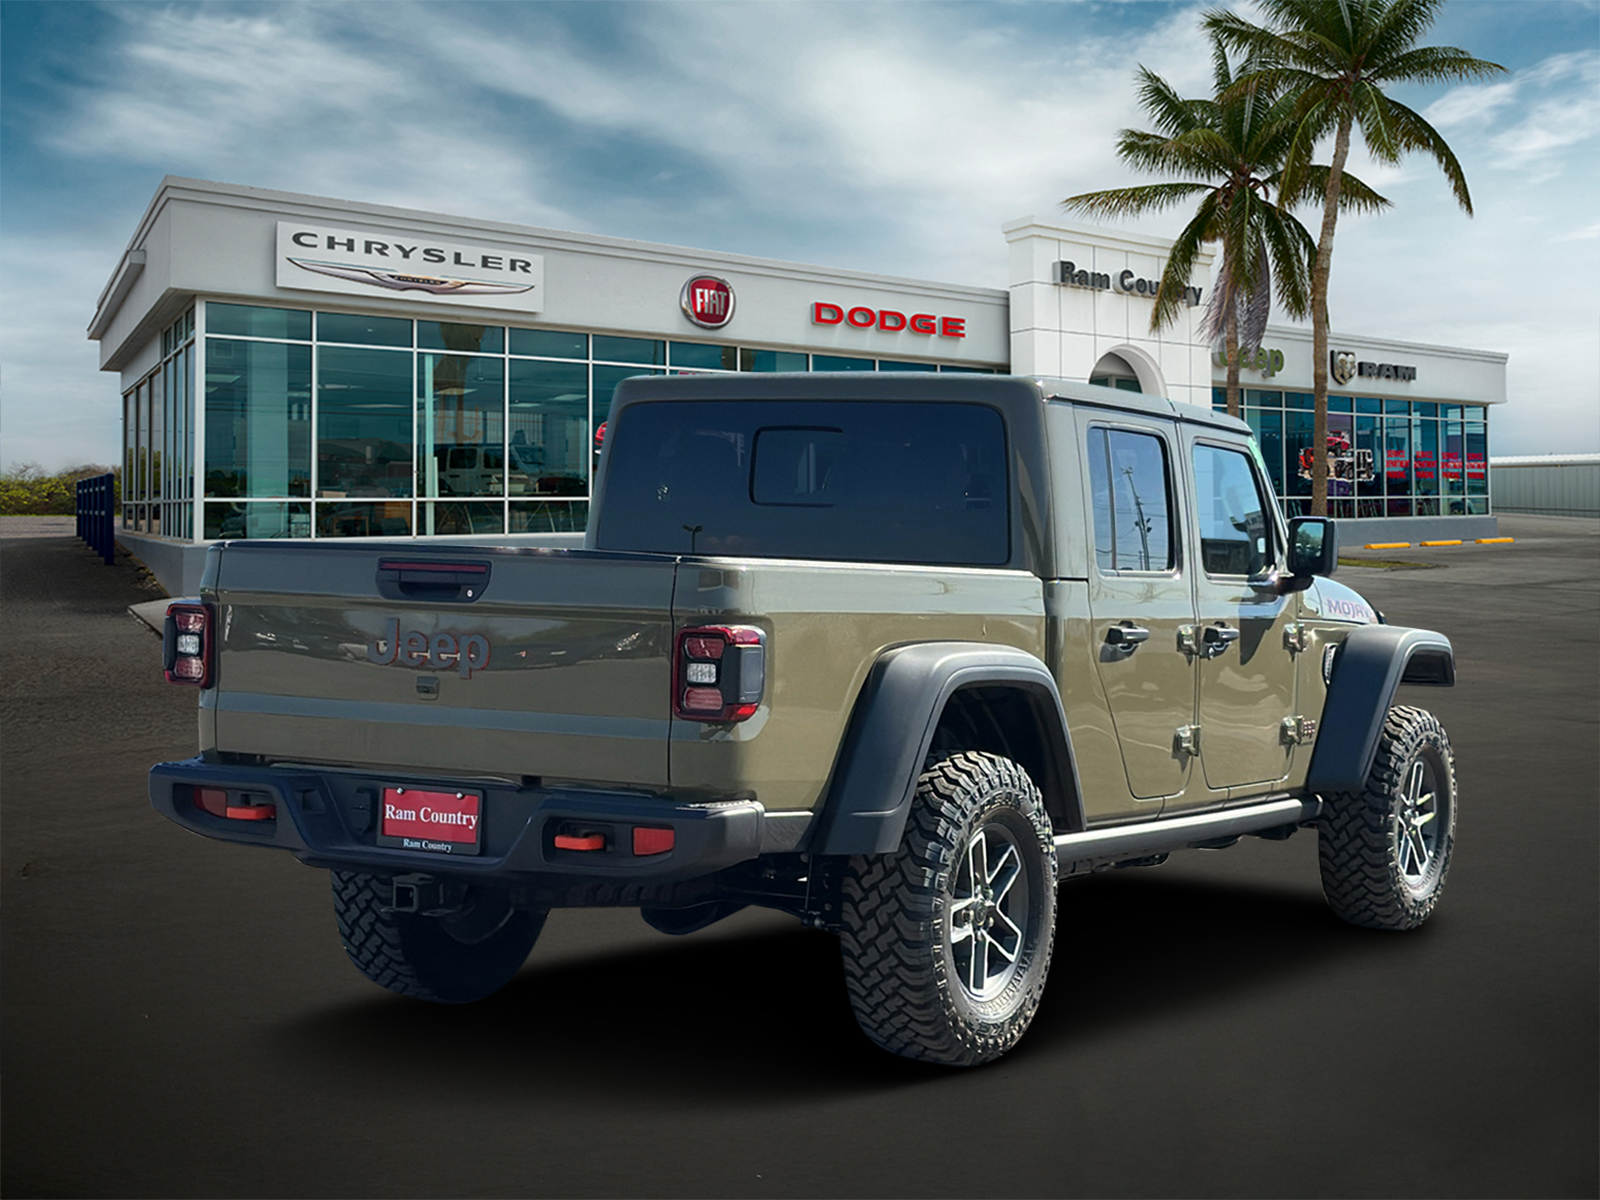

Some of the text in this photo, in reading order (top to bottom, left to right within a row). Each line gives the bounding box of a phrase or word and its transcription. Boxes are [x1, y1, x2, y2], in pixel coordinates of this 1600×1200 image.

[291, 231, 533, 274] CHRYSLER
[1052, 260, 1203, 307] Ram Coury
[695, 288, 728, 316] FIAT
[811, 301, 966, 338] DODGE
[1358, 361, 1416, 381] RAM
[367, 617, 491, 680] Jeep
[384, 804, 478, 829] Ram Country
[403, 838, 452, 853] Ram Country
